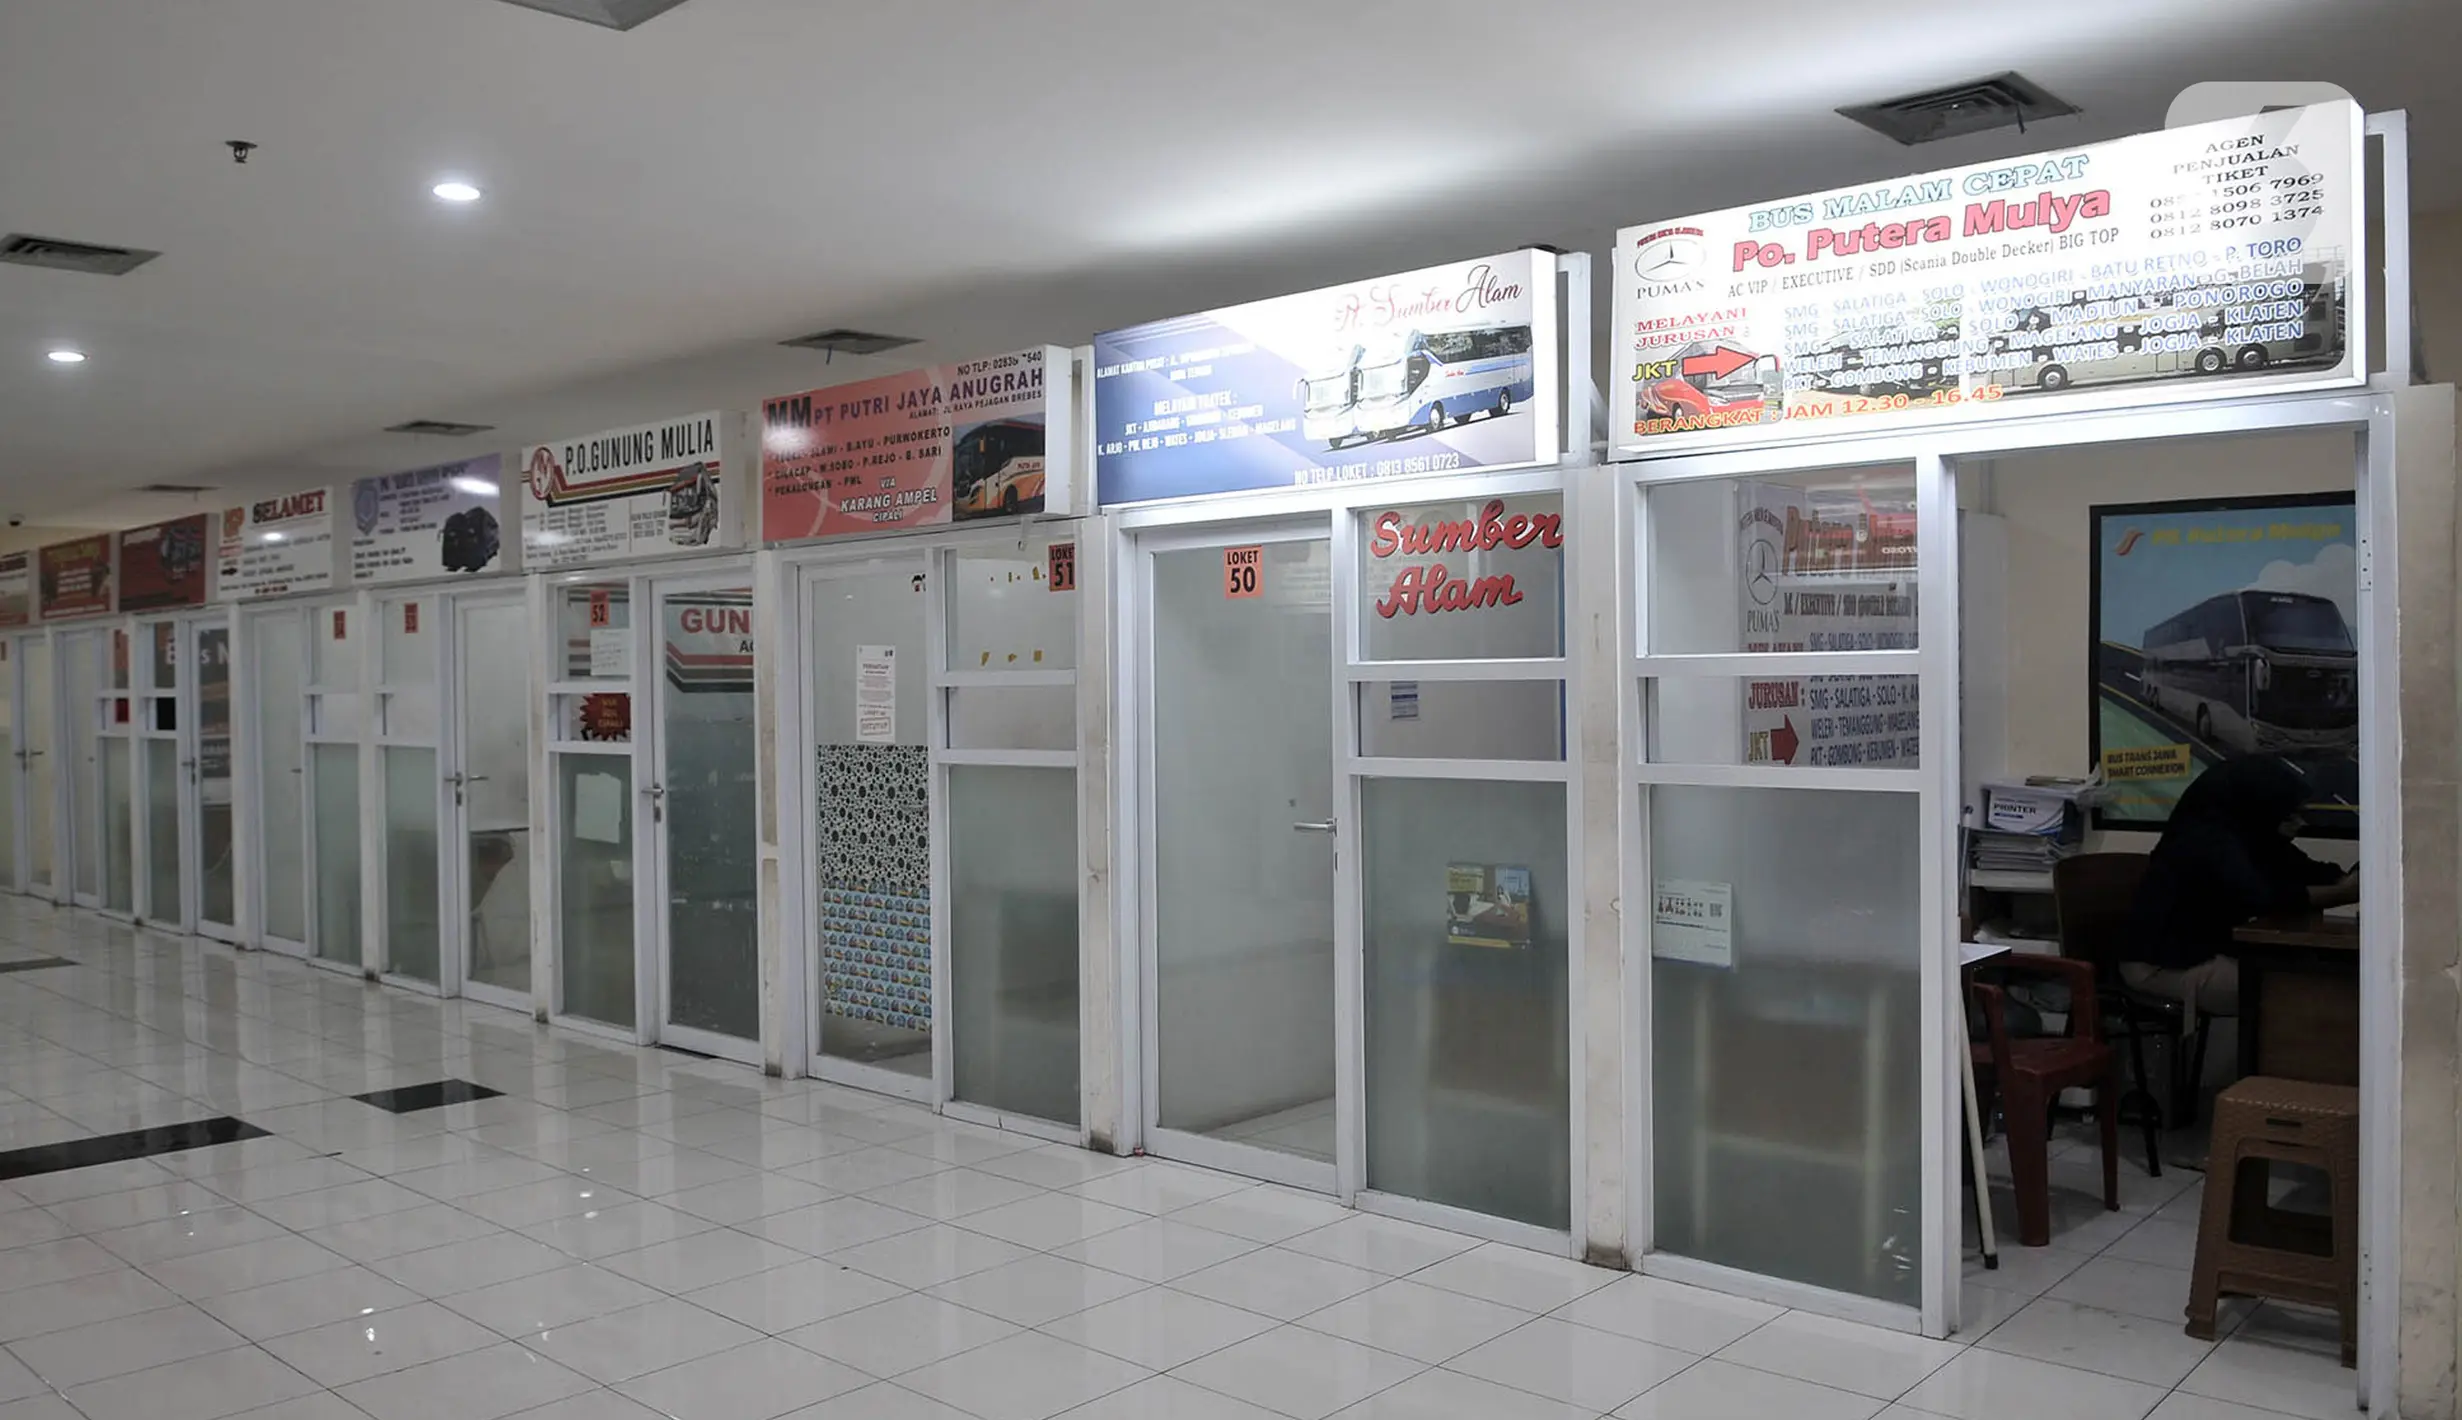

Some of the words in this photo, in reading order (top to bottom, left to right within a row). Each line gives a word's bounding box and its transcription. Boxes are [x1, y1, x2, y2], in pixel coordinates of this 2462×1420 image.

[2205, 134, 2265, 153] AGEN
[2172, 144, 2299, 174] PENJUALAN
[2203, 165, 2269, 184] TIKET
[2269, 172, 2324, 191] 7969
[1749, 203, 1814, 233] BUS
[1822, 178, 1953, 220] MALAM
[1963, 154, 2090, 197] CEPAT
[2150, 207, 2201, 225] 0812
[2209, 198, 2262, 216] 8098
[2269, 189, 2324, 207] 3725
[1733, 239, 1796, 273] Po.
[1806, 215, 1952, 261] Putera
[1963, 189, 2110, 237] Mulya
[2150, 223, 2201, 240] 0812
[2209, 214, 2262, 232] 8070
[2272, 206, 2324, 224] 1374
[1747, 279, 1768, 295] VIP
[1781, 266, 1854, 290] EXECUTIVE
[1868, 260, 1896, 278] SDD
[1951, 245, 1996, 266] Double
[2059, 232, 2085, 250] BIG
[2089, 227, 2119, 246] TOP
[1454, 264, 1524, 313] Alam
[1784, 303, 1819, 320] SMG
[1833, 292, 1906, 313] SALATIGA
[1922, 284, 1964, 302] SOLO
[1980, 268, 2074, 293] WONOGIRI
[2090, 259, 2138, 280] BATU
[2144, 250, 2206, 273] RETNO
[2245, 237, 2302, 259] TORO
[1784, 321, 1819, 338] SMG
[1833, 311, 1906, 331] SALATIGA
[1921, 302, 1963, 320] SOLO
[1979, 289, 2072, 314] WONOGIRI
[2087, 273, 2196, 299] MANYARAN
[2240, 259, 2302, 280] BELAH
[1636, 307, 1747, 332] MELAYANI
[1784, 339, 1821, 356] SMG
[1851, 323, 1938, 348] SALATIGA
[1968, 315, 2019, 336] SOLO
[2050, 299, 2139, 324] MADIUN
[2173, 279, 2303, 308] PONOROGO
[1634, 326, 1735, 350] JURUSAN
[1784, 353, 1842, 373] WELERI
[1861, 337, 1988, 365] TEMANGGUNG
[2009, 323, 2117, 348] MAGELANG
[2139, 312, 2201, 334] JOGJA
[2225, 300, 2303, 325] KLATEN
[1831, 363, 1923, 387] GOMBONG
[1942, 350, 2033, 376] KEBUMEN
[2053, 342, 2118, 364] WATES
[2140, 331, 2201, 355] JOGJA
[2225, 321, 2303, 345] KLATEN
[956, 364, 972, 376] NO
[1633, 360, 1678, 382] JKT
[814, 406, 835, 426] PT
[840, 397, 889, 420] PUTRI
[897, 385, 943, 411] JAYA
[949, 367, 1043, 401] ANUGRAH
[953, 401, 974, 413] RAYA
[1634, 408, 1765, 434] BERANGKAT
[1785, 402, 1833, 420] JAM
[1842, 394, 1909, 415] 12.30
[1932, 383, 2003, 407] 16.45
[565, 431, 654, 477] P.O.GUNUNG
[661, 419, 714, 460] MULIA
[883, 426, 950, 447] PURWOKERTO
[1339, 462, 1368, 482] LOKET
[1433, 452, 1460, 471] 0723
[253, 490, 325, 523] SELAMET
[840, 495, 893, 513] KARANG
[895, 488, 938, 507] AMPEL
[1371, 500, 1564, 559] Sumber
[1227, 549, 1259, 566] LOKET
[1054, 562, 1074, 587] 51
[1230, 566, 1257, 593] 50
[1376, 563, 1524, 618] Alam
[1810, 689, 1829, 710] SMG
[1834, 685, 1871, 709] SALATIGA
[1876, 683, 1897, 706] SOLO
[1748, 731, 1769, 762] JKT
[2108, 754, 2123, 763] BUS
[1994, 803, 2035, 814] PRINTER
